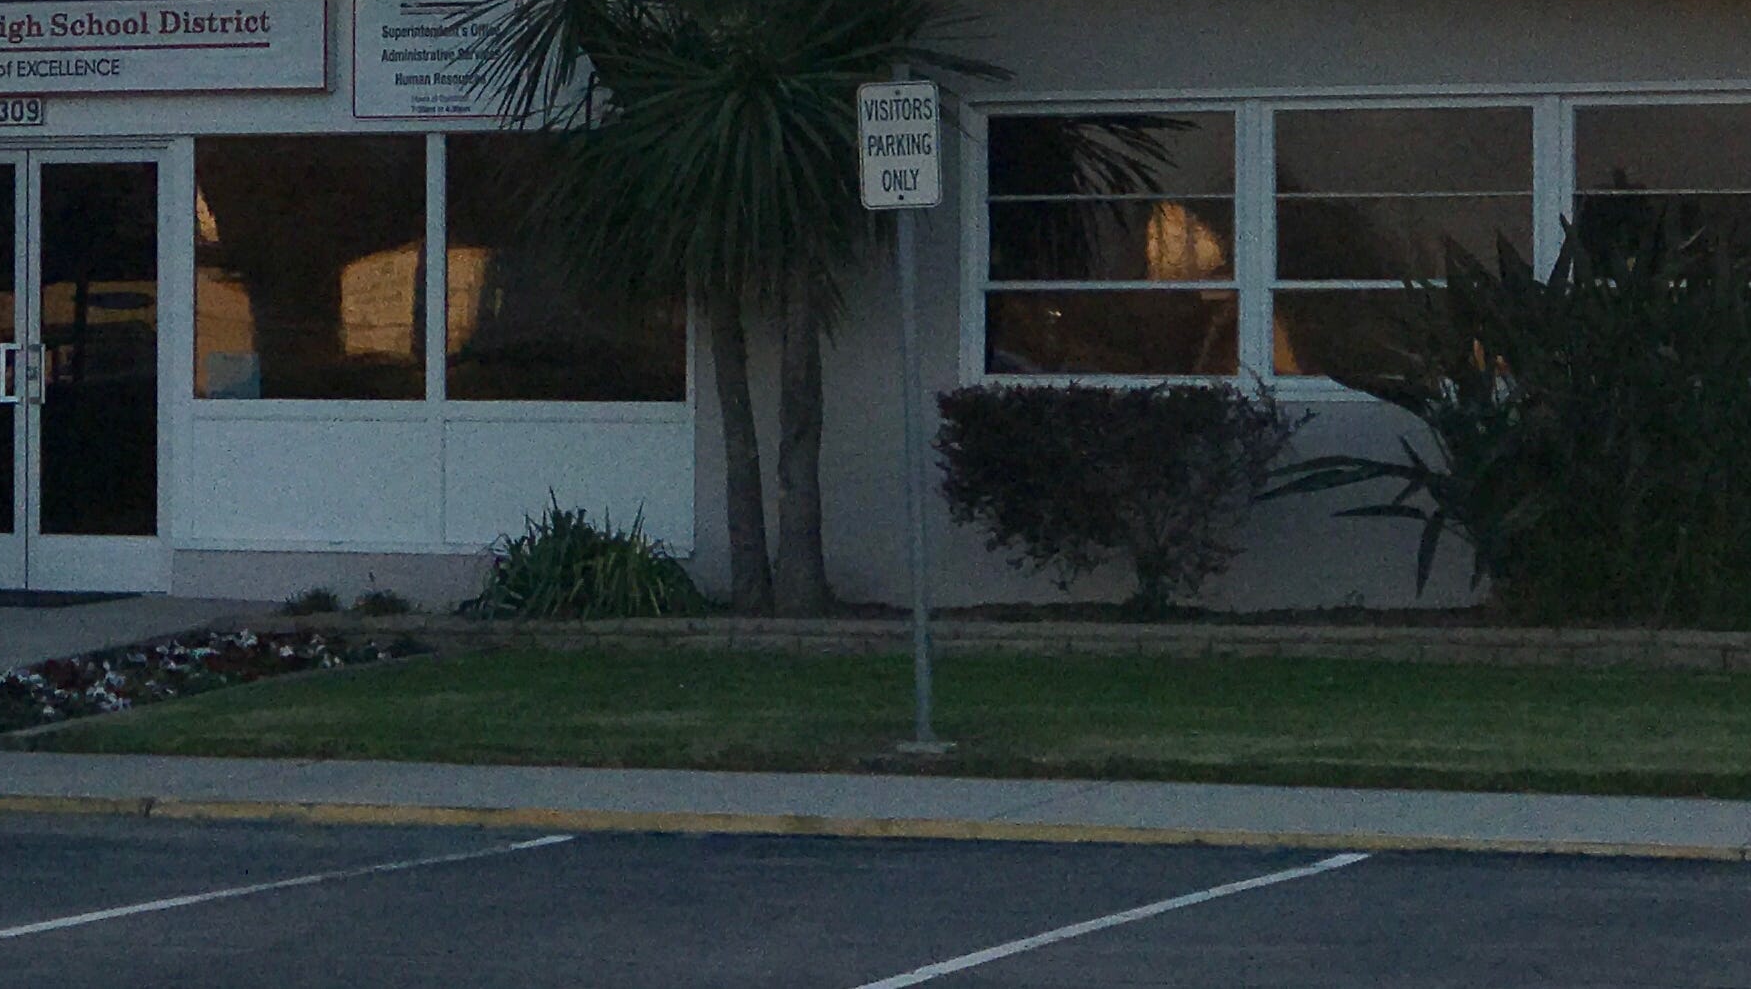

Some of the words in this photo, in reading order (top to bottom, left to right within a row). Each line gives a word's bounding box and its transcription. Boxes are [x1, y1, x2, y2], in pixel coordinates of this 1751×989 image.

[50, 11, 150, 37] School
[158, 9, 271, 35] District
[381, 48, 455, 62] Administrative
[17, 58, 120, 78] EXCELLENCE
[395, 72, 431, 86] Human
[864, 98, 932, 121] VISITORS
[867, 133, 932, 157] PARKING
[882, 169, 919, 192] ONLY
